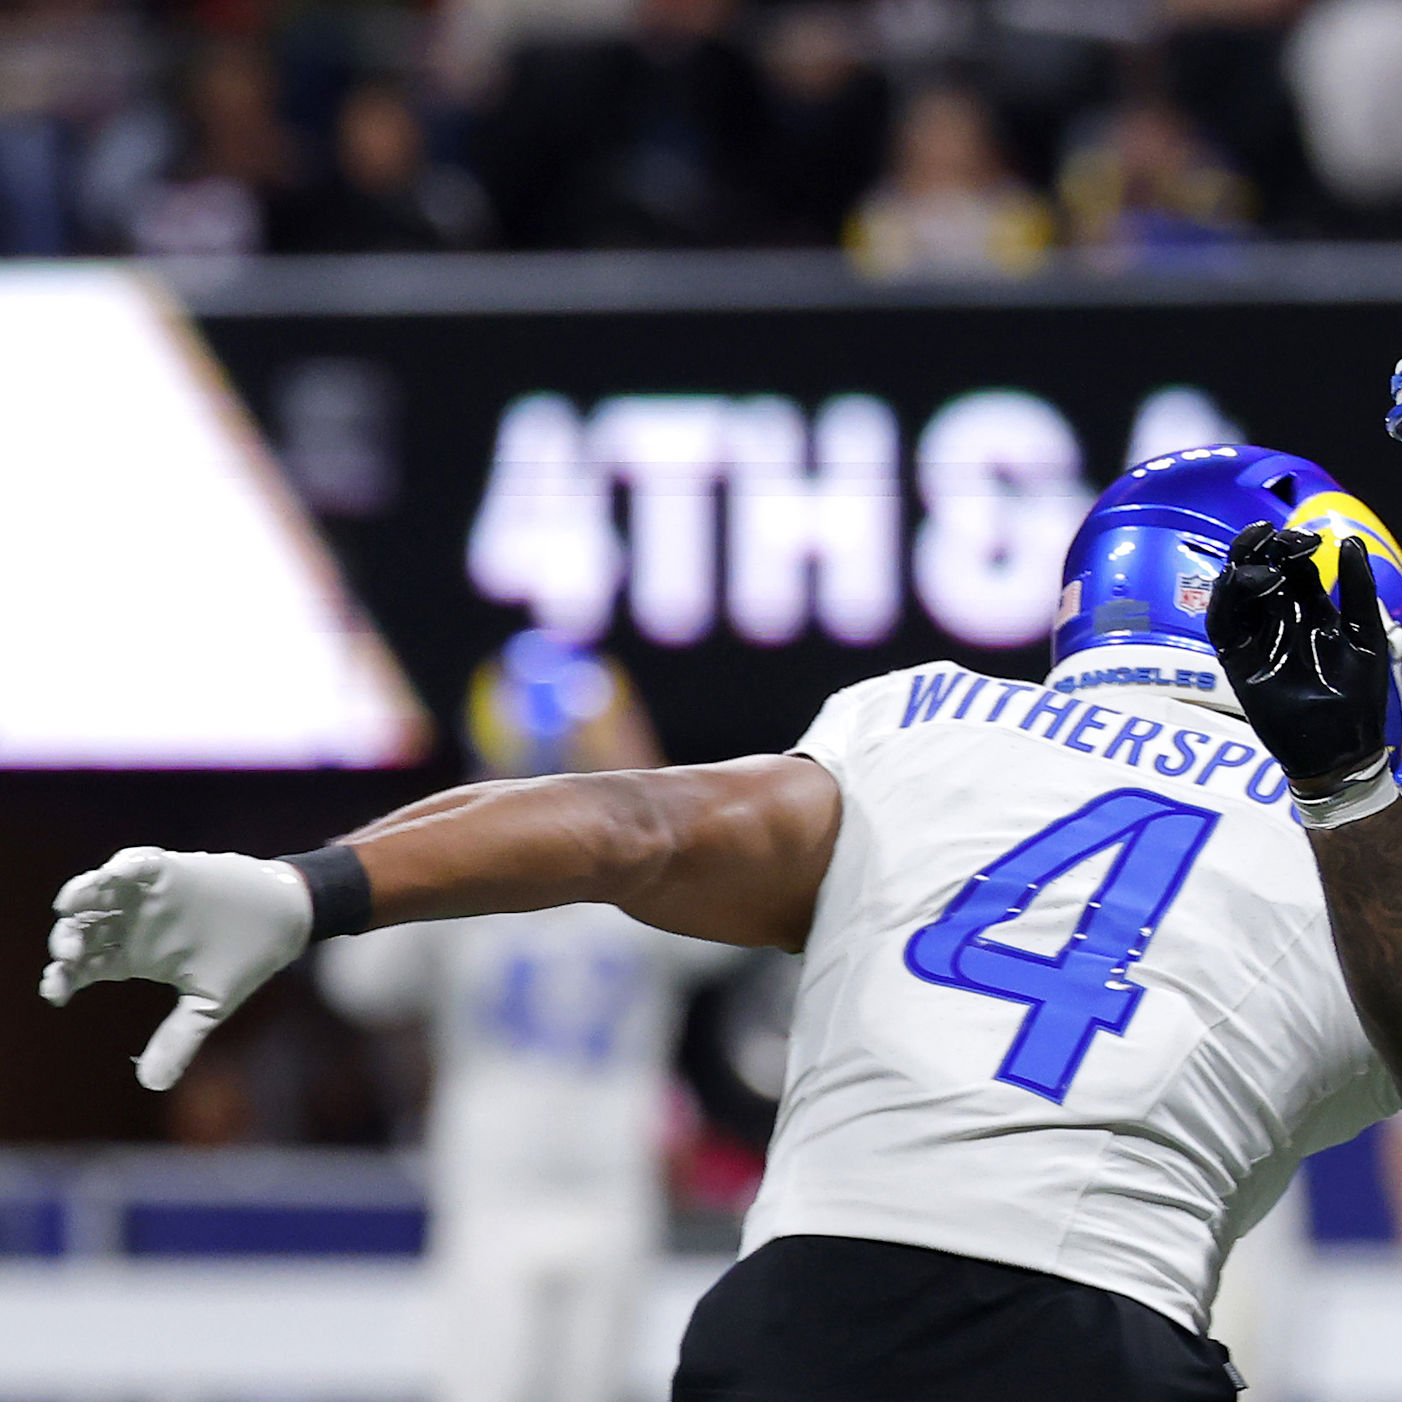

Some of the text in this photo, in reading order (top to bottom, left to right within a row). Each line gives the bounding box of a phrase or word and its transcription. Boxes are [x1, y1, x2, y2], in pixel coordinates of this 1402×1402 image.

[466, 388, 902, 647] 4TH
[914, 388, 1096, 648] &
[900, 671, 1304, 823] WITHERSPO
[904, 786, 1223, 1105] 4
